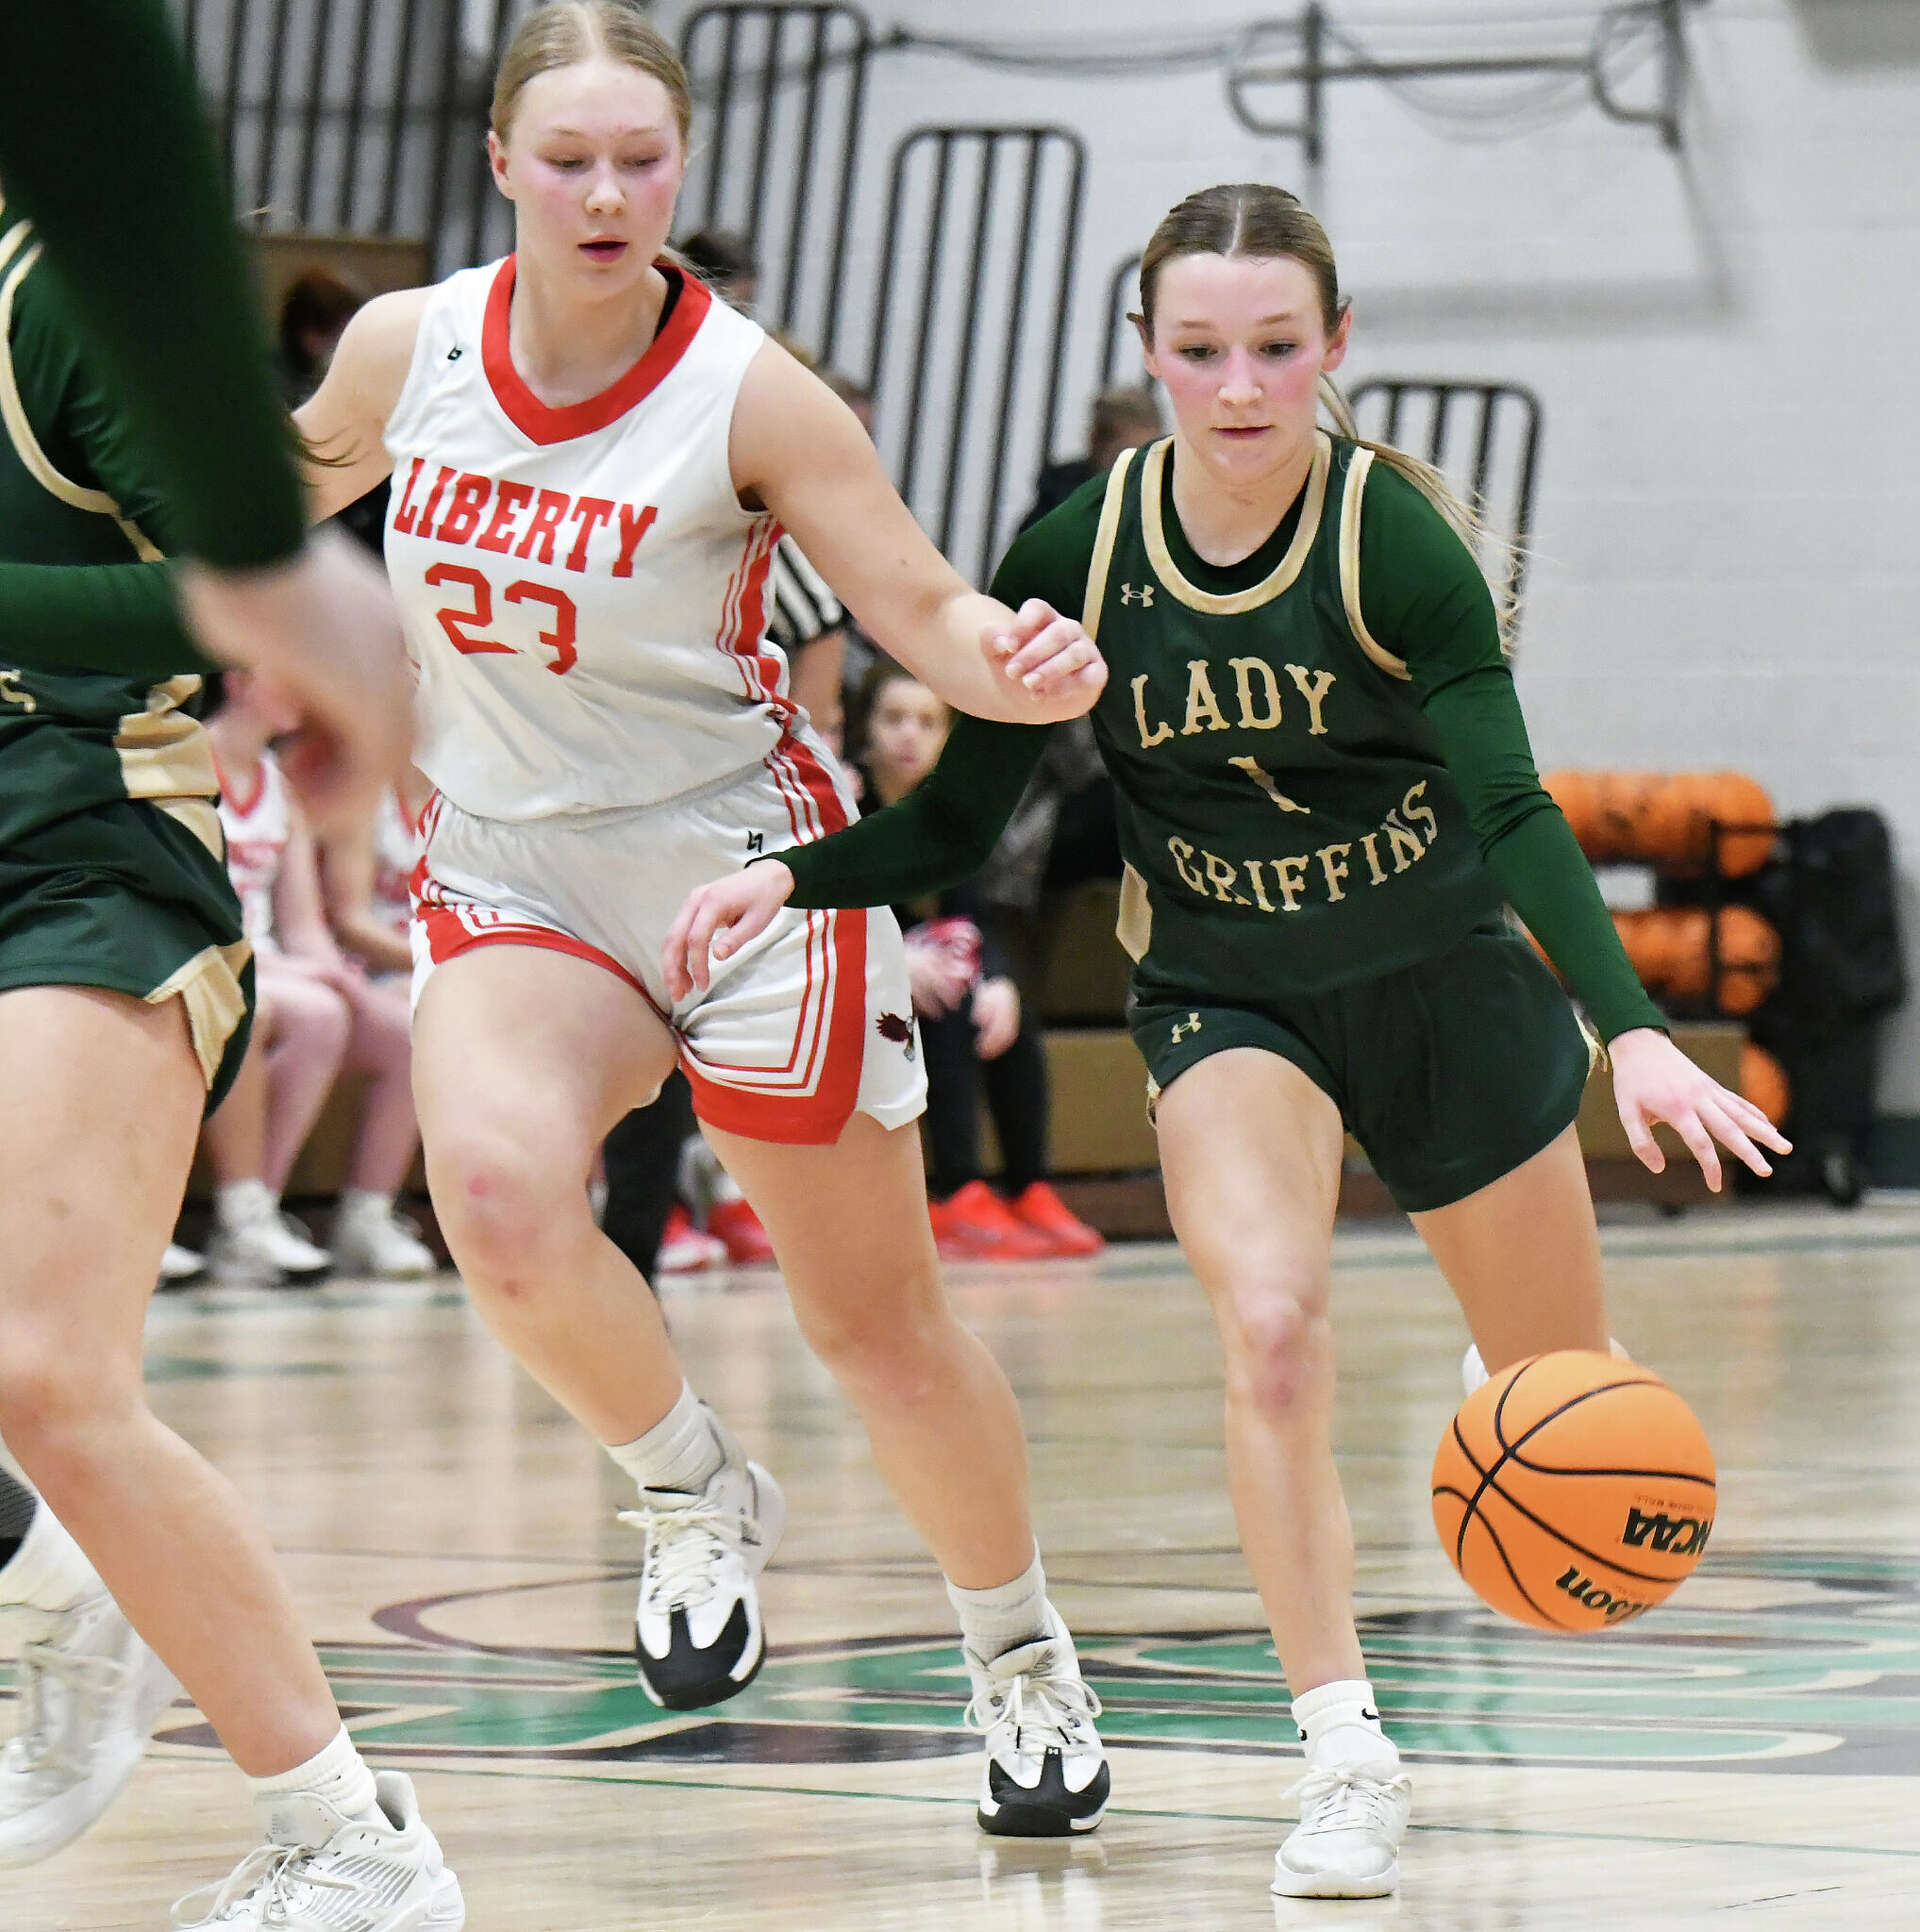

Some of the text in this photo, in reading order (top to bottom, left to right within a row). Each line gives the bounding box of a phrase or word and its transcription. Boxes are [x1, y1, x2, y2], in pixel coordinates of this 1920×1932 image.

[393, 457, 658, 578] LIBERTY
[424, 562, 578, 675] 23
[1131, 656, 1336, 749] LADY
[1227, 756, 1311, 814] 1
[1167, 780, 1438, 913] GRIFFINS
[1622, 1507, 1714, 1556] NCAA
